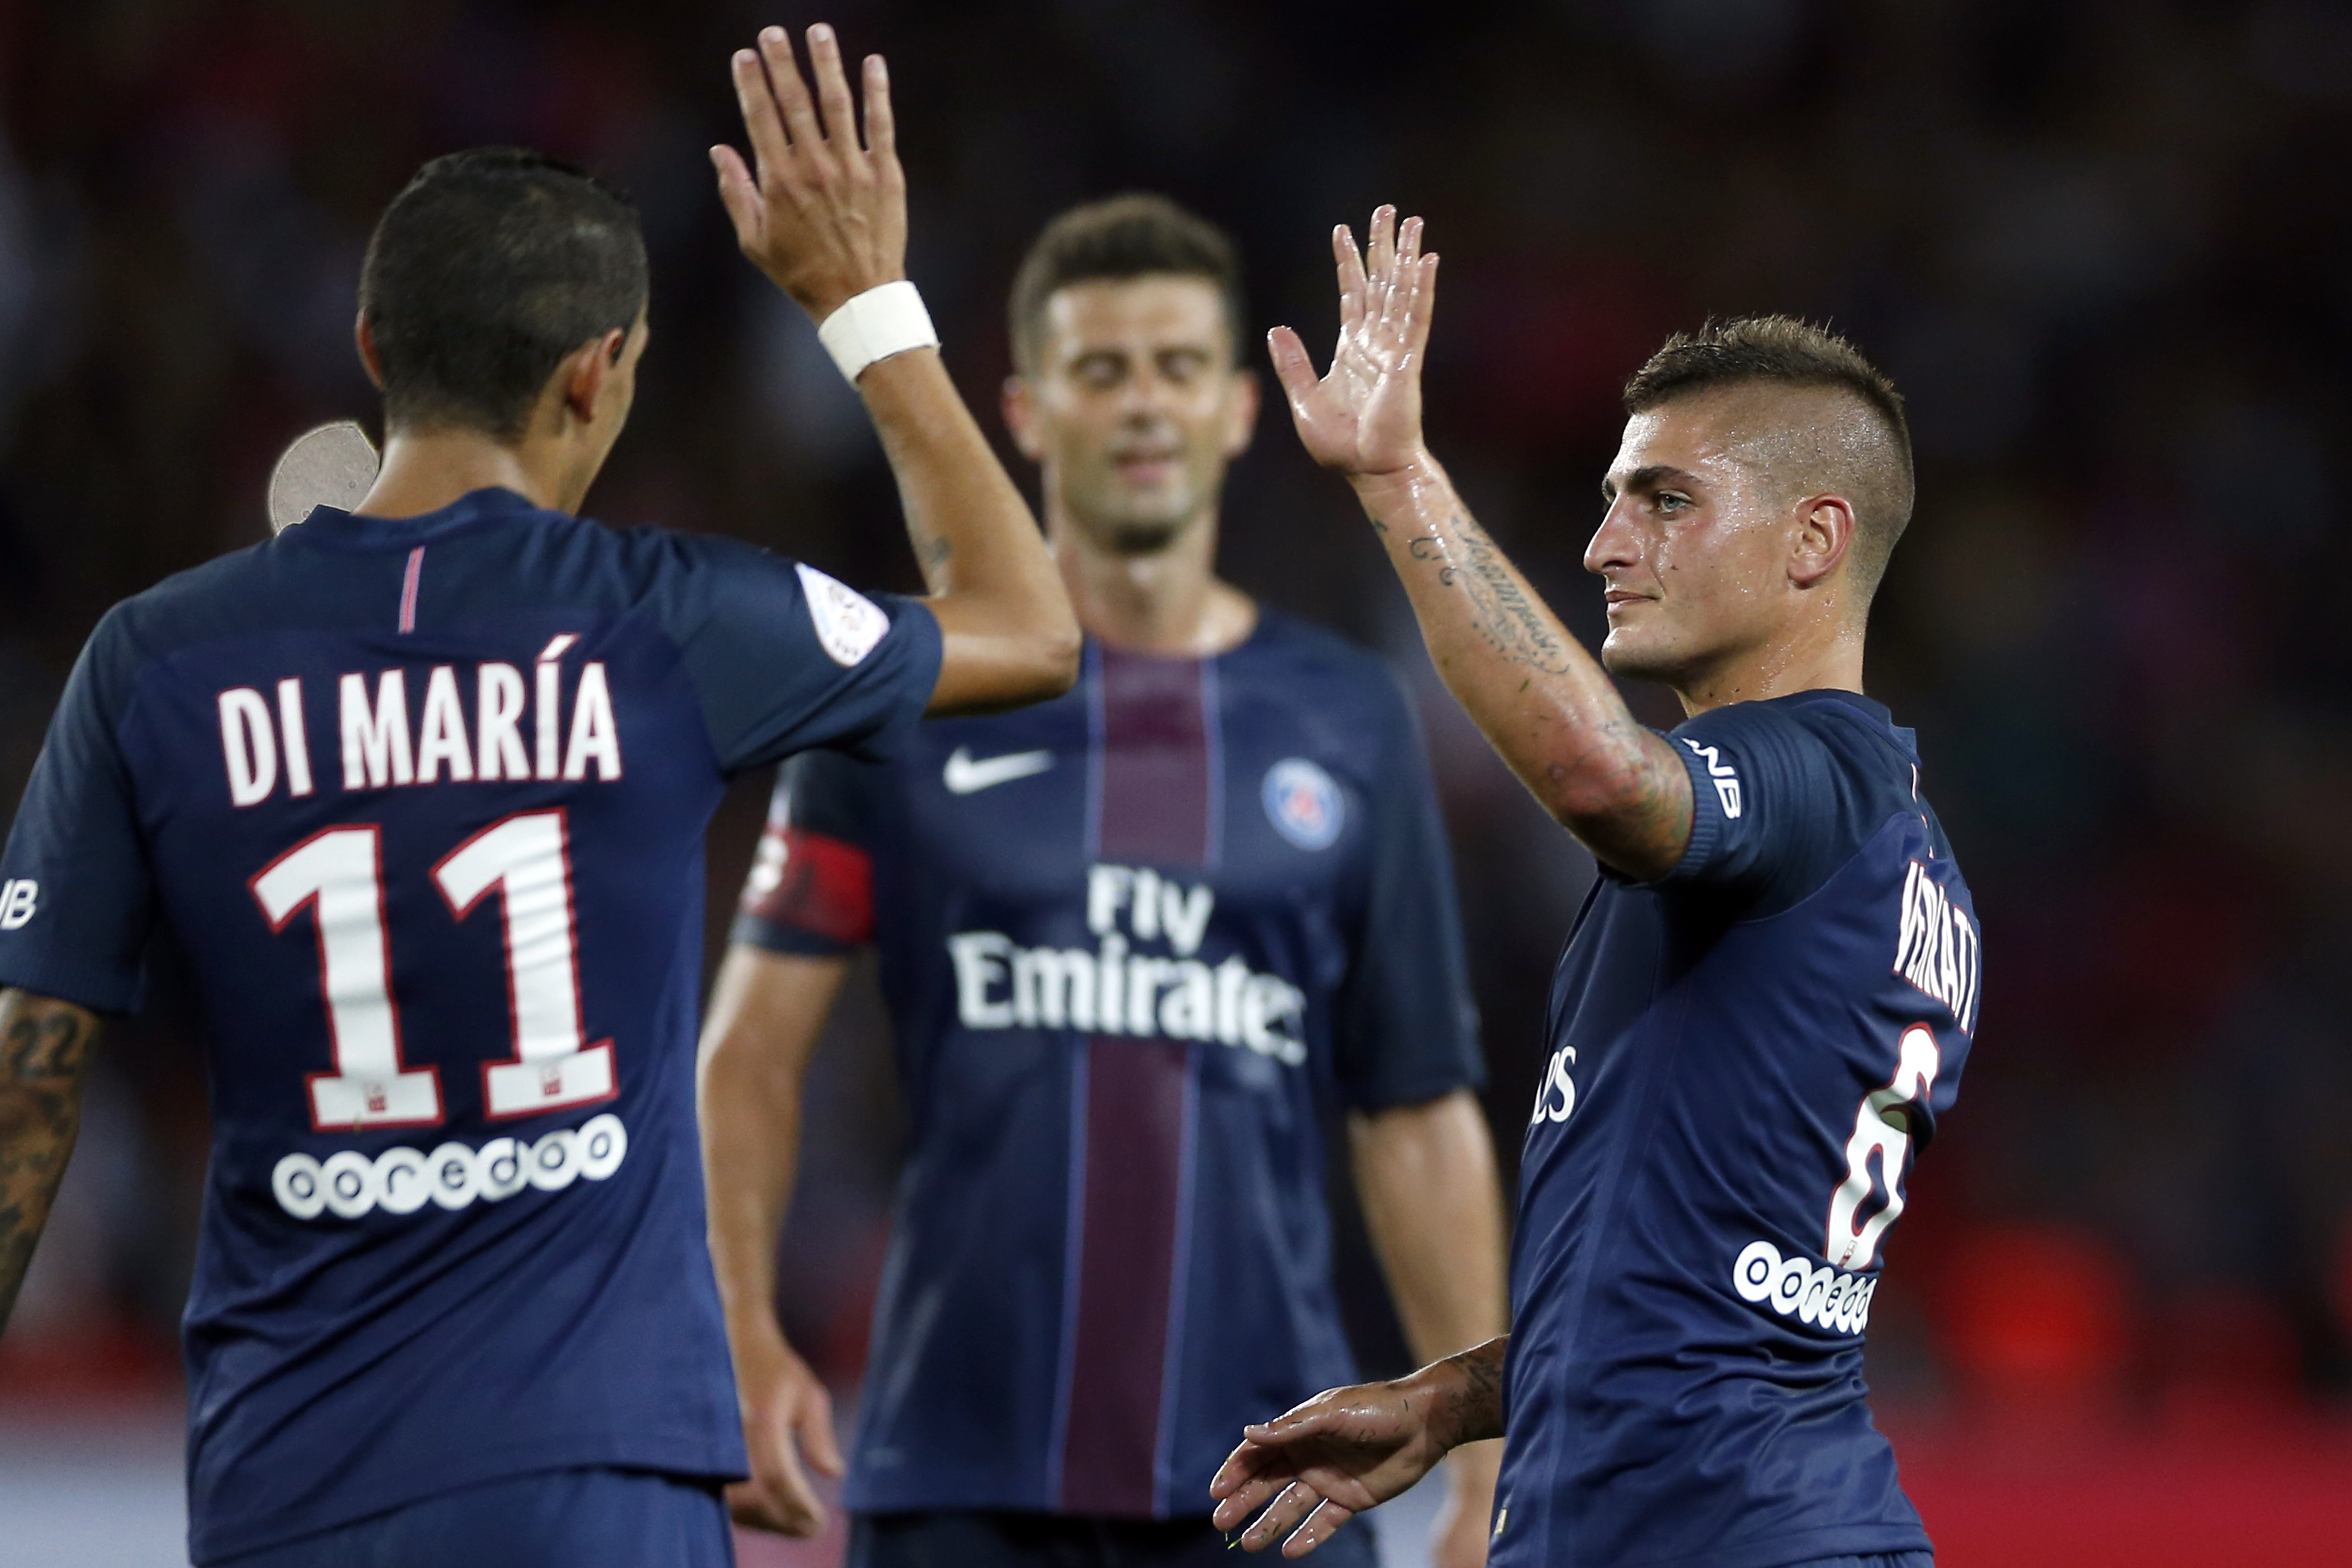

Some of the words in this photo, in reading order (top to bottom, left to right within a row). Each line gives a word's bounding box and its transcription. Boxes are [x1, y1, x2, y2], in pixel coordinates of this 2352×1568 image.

[218, 679, 314, 807] DI
[339, 633, 623, 789] MARÍA
[1682, 738, 1741, 819] NB
[248, 807, 619, 1131] 11
[1087, 863, 1214, 953] Fly
[1893, 858, 1977, 1038] VERRATT
[275, 1114, 626, 1217] ooredoo
[1824, 1021, 1941, 1271] 6
[1733, 1240, 1877, 1335] ooredo
